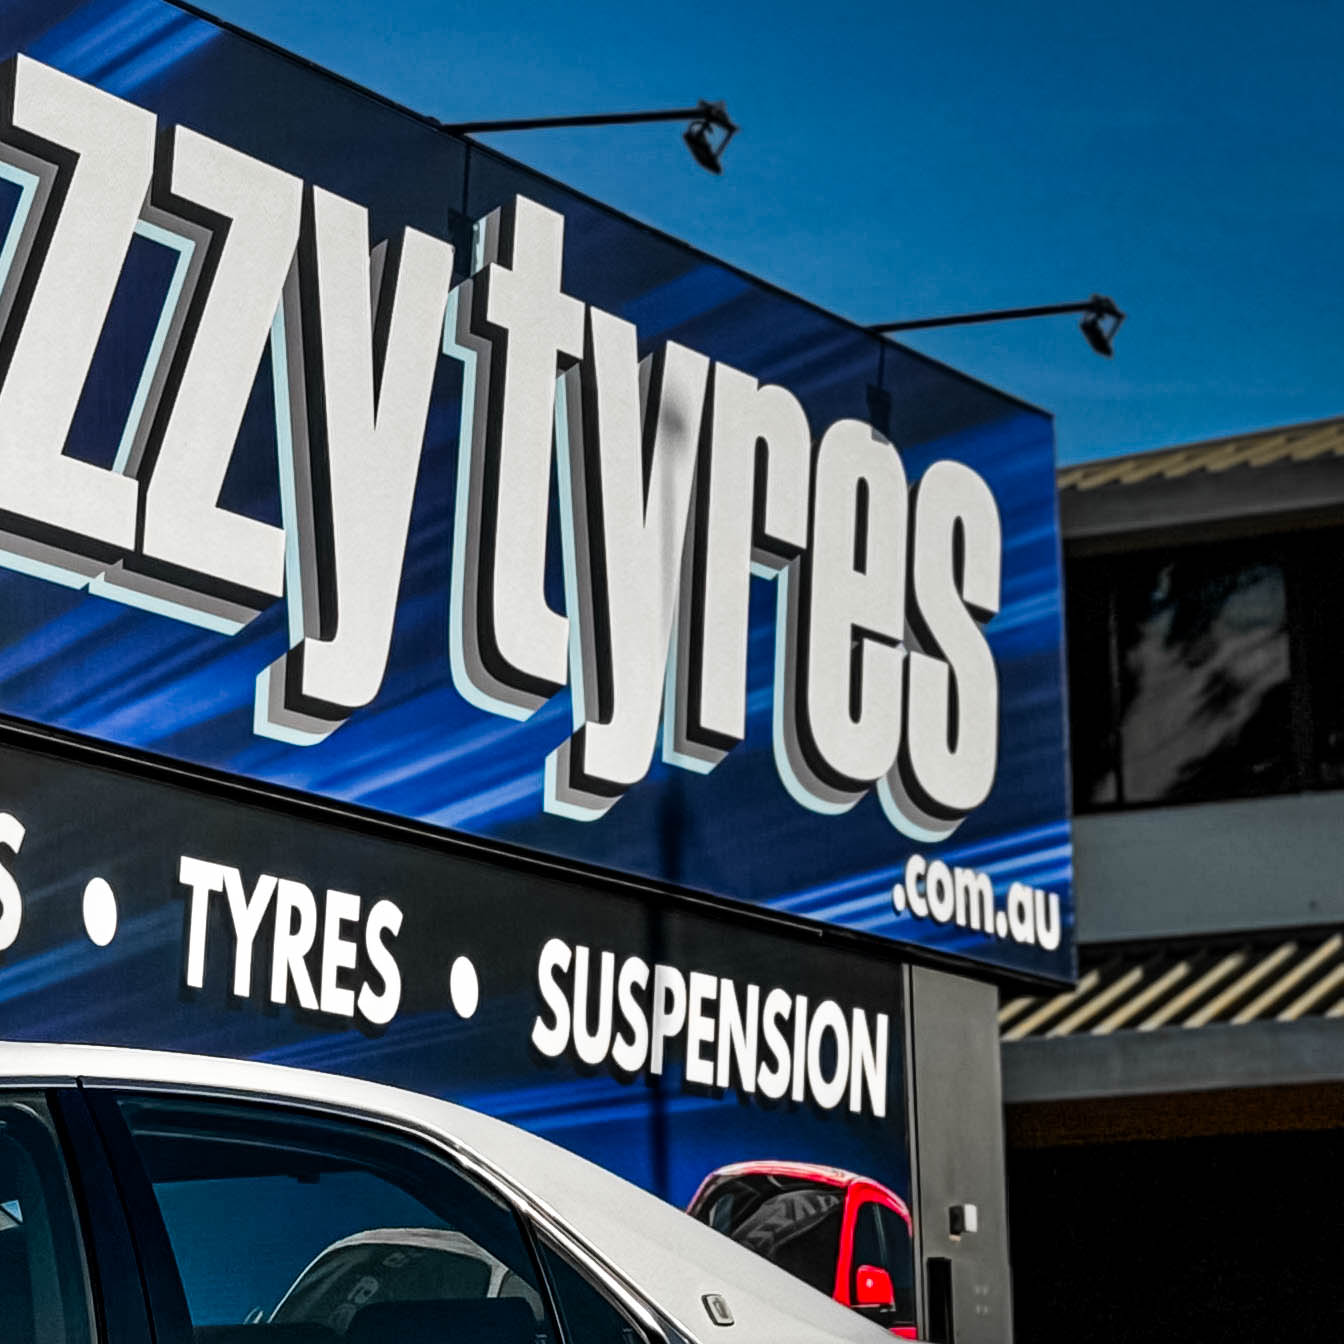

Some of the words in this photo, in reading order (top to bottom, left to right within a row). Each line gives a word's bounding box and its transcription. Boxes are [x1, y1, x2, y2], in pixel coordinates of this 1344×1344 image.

[179, 857, 404, 1026] TYRES
[532, 938, 890, 1118] SUSPENSION
[892, 853, 1061, 951] .com.au
